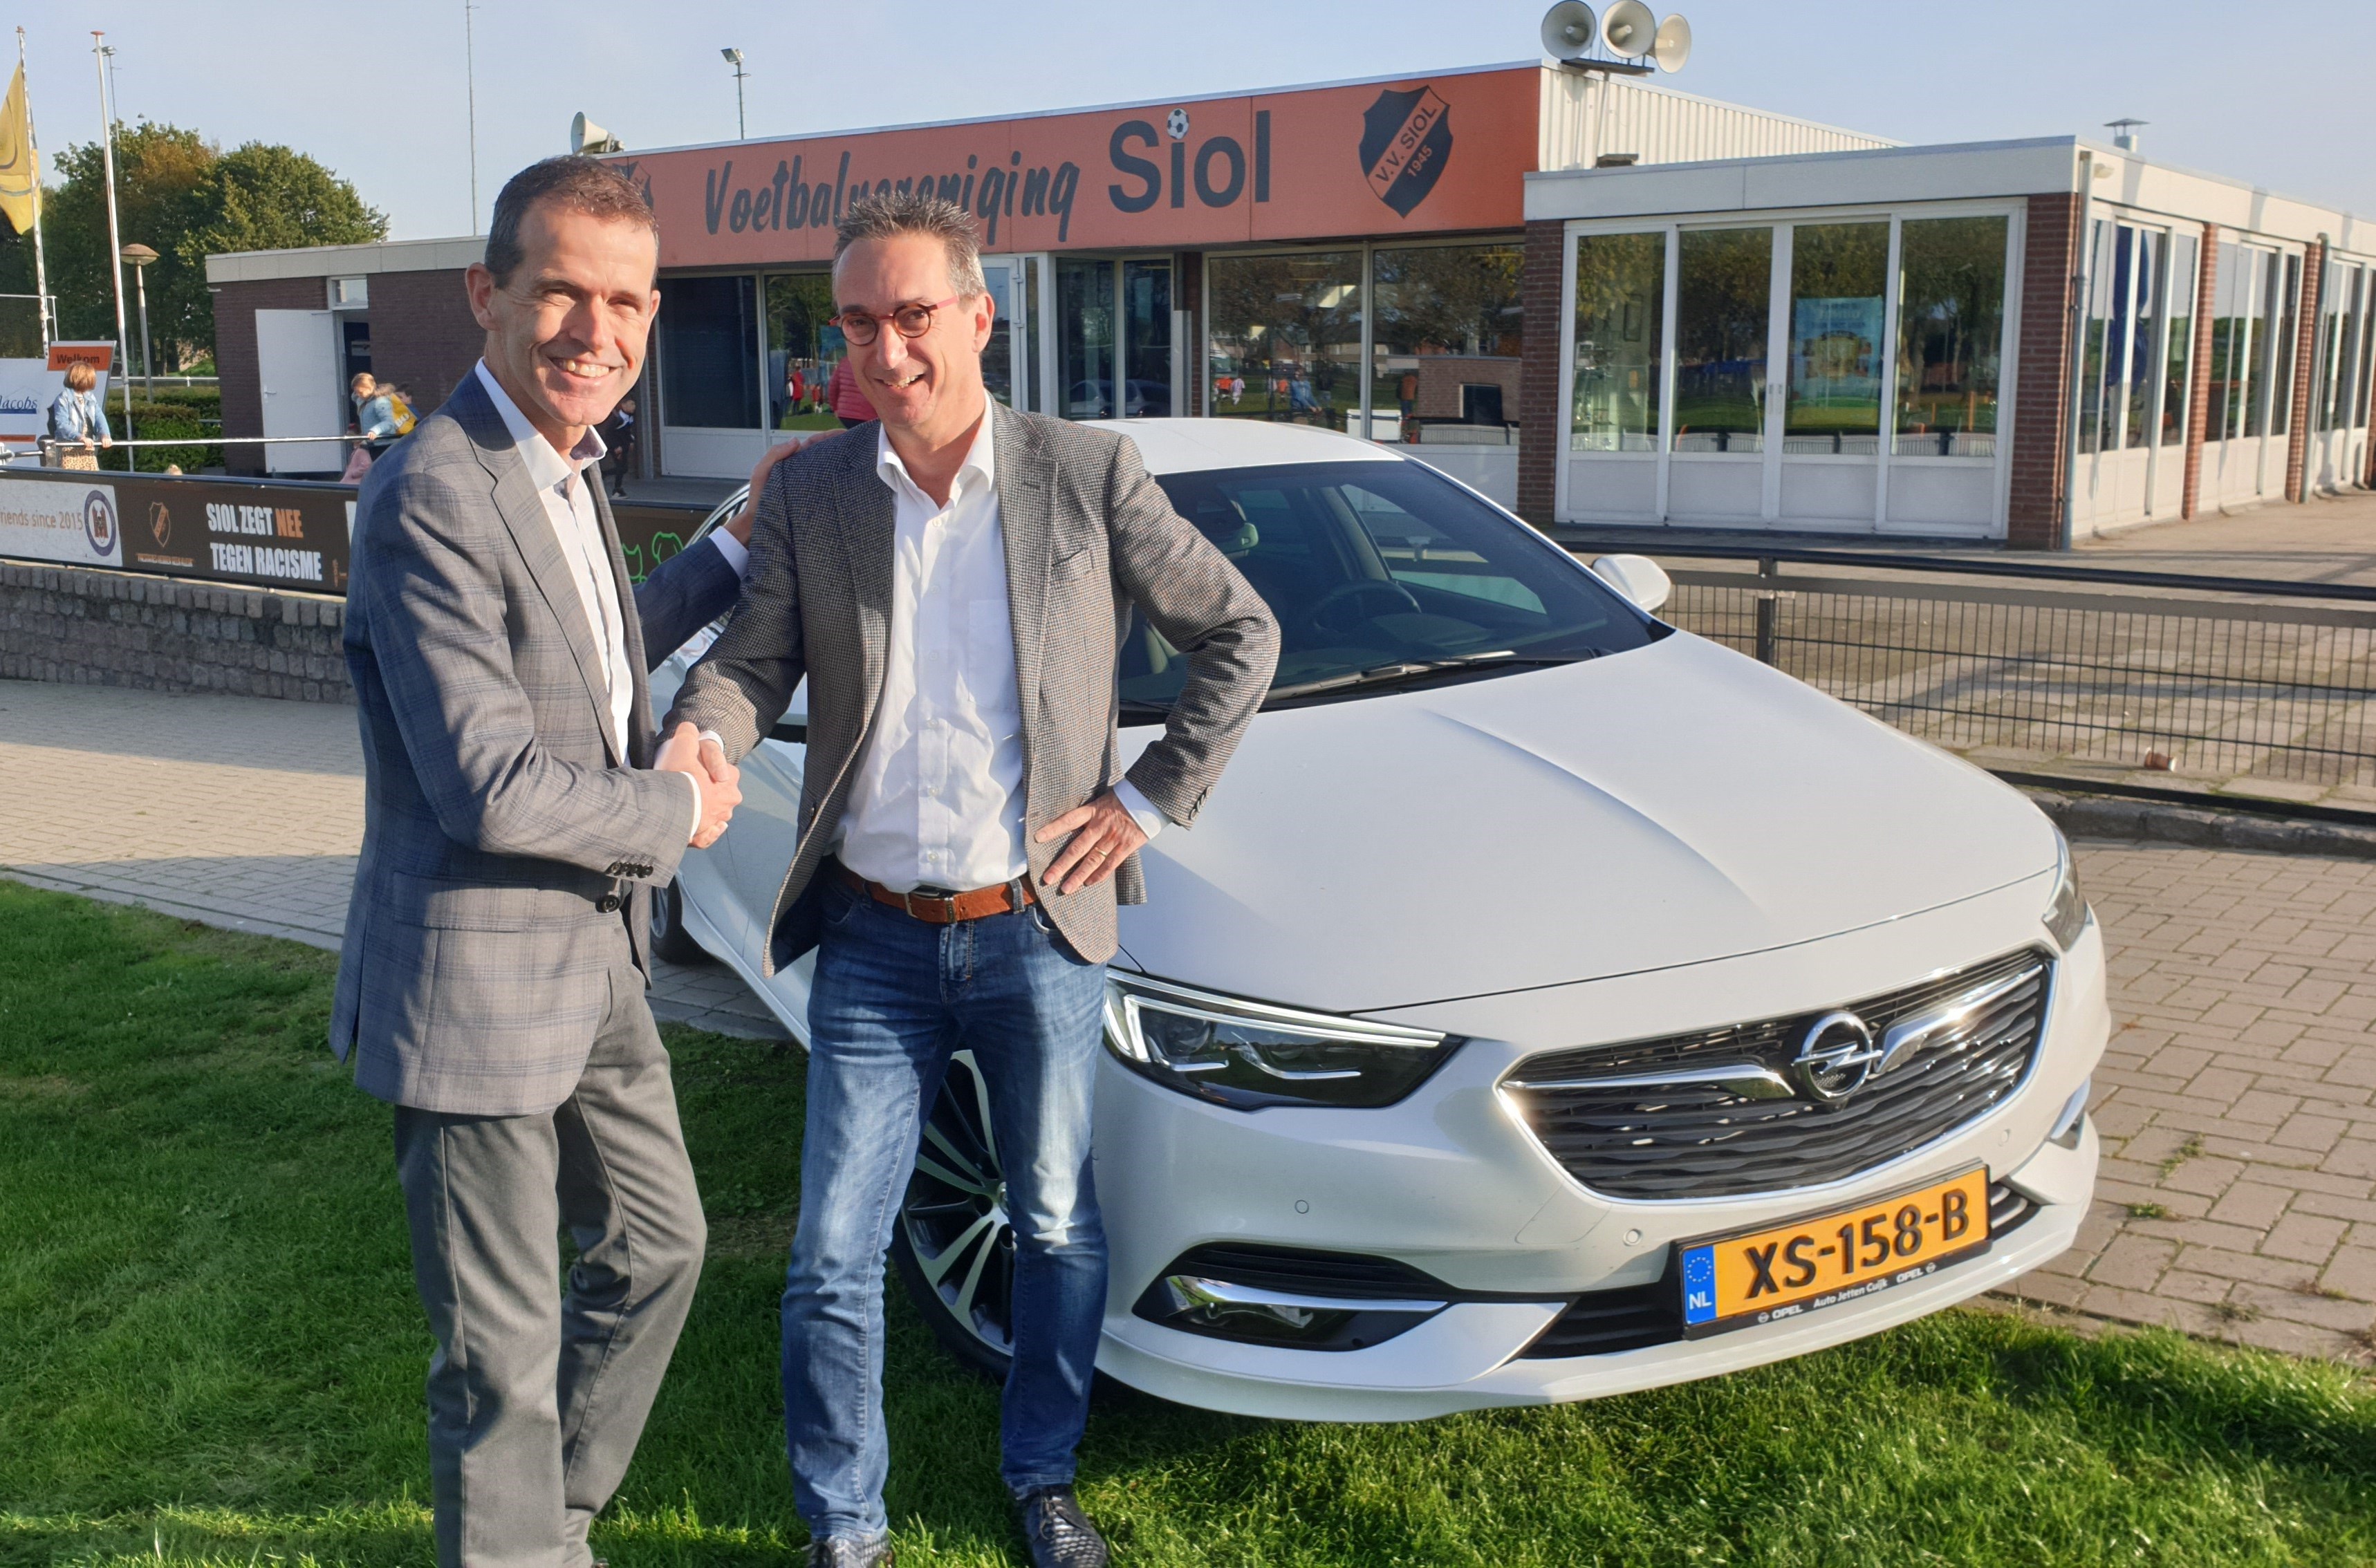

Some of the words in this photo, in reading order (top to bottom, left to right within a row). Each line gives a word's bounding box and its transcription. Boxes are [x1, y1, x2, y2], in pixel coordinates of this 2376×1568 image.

[1400, 106, 1438, 150] SIOL
[1108, 109, 1271, 214] Siol
[1407, 144, 1433, 178] 1945
[56, 353, 100, 364] Welkom
[32, 510, 57, 528] since
[58, 511, 84, 531] 2015
[205, 503, 239, 533] SIOL
[239, 505, 273, 536] ZEGT
[275, 507, 304, 539] NEE
[210, 542, 254, 574] TEGEN
[254, 546, 323, 581] RACISME
[1743, 1187, 1969, 1300] XS-158-B
[1688, 1290, 1712, 1311] NL
[1772, 1304, 1803, 1320] OPEL
[1813, 1297, 1837, 1308] Auto
[1837, 1286, 1866, 1303] Jetten
[1866, 1278, 1888, 1293] Cuijk
[1896, 1267, 1924, 1284] OPEL
